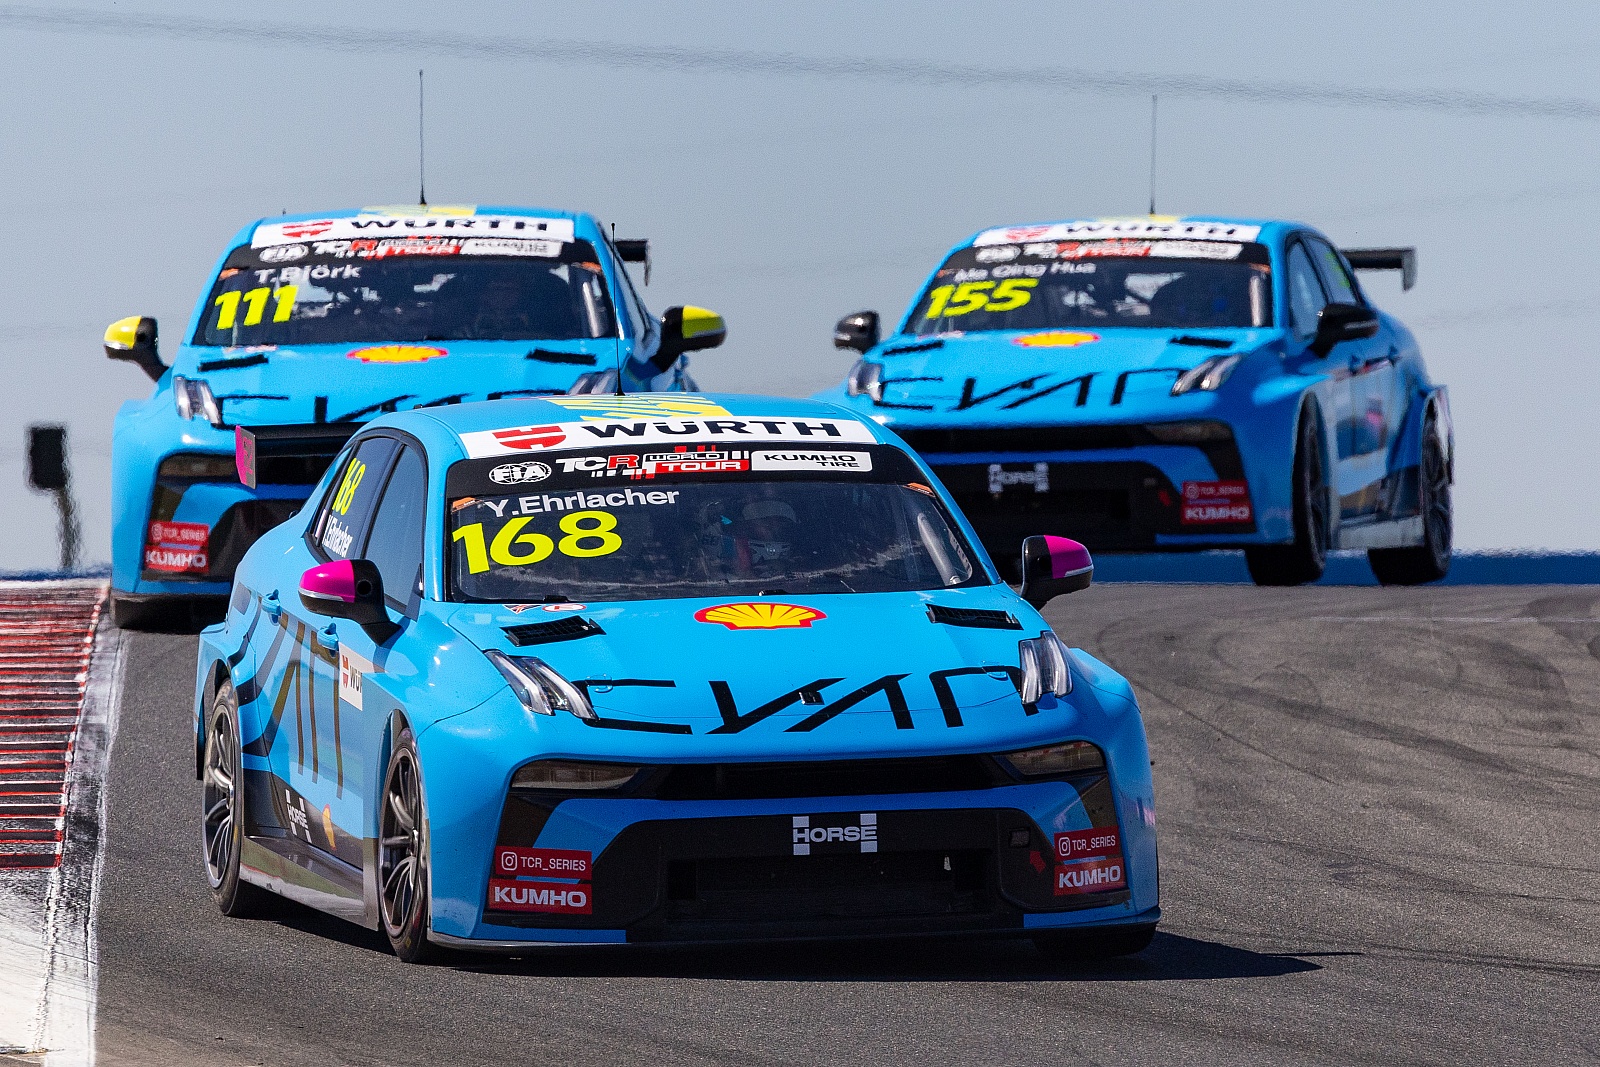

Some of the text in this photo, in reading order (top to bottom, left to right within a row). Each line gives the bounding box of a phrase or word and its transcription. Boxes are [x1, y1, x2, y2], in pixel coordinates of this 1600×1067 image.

[254, 264, 361, 284] T.Björk
[215, 285, 298, 330] 111
[926, 277, 1039, 319] 155
[582, 420, 841, 438] WÜRTH
[556, 454, 639, 473] TCR
[650, 453, 721, 461] WORLD
[662, 461, 742, 472] TOUR
[764, 453, 856, 462] KUMHO
[331, 457, 366, 516] 168
[484, 488, 680, 518] Y.Ehrlacher
[1184, 506, 1250, 520] KUMHO
[452, 510, 623, 575] 168
[145, 550, 207, 568] KUMHO
[1072, 835, 1116, 851] TCR_SERIES
[520, 856, 586, 871] TCR_SERIES
[1058, 865, 1121, 888] KUMHO
[494, 886, 587, 907] KUMHO
